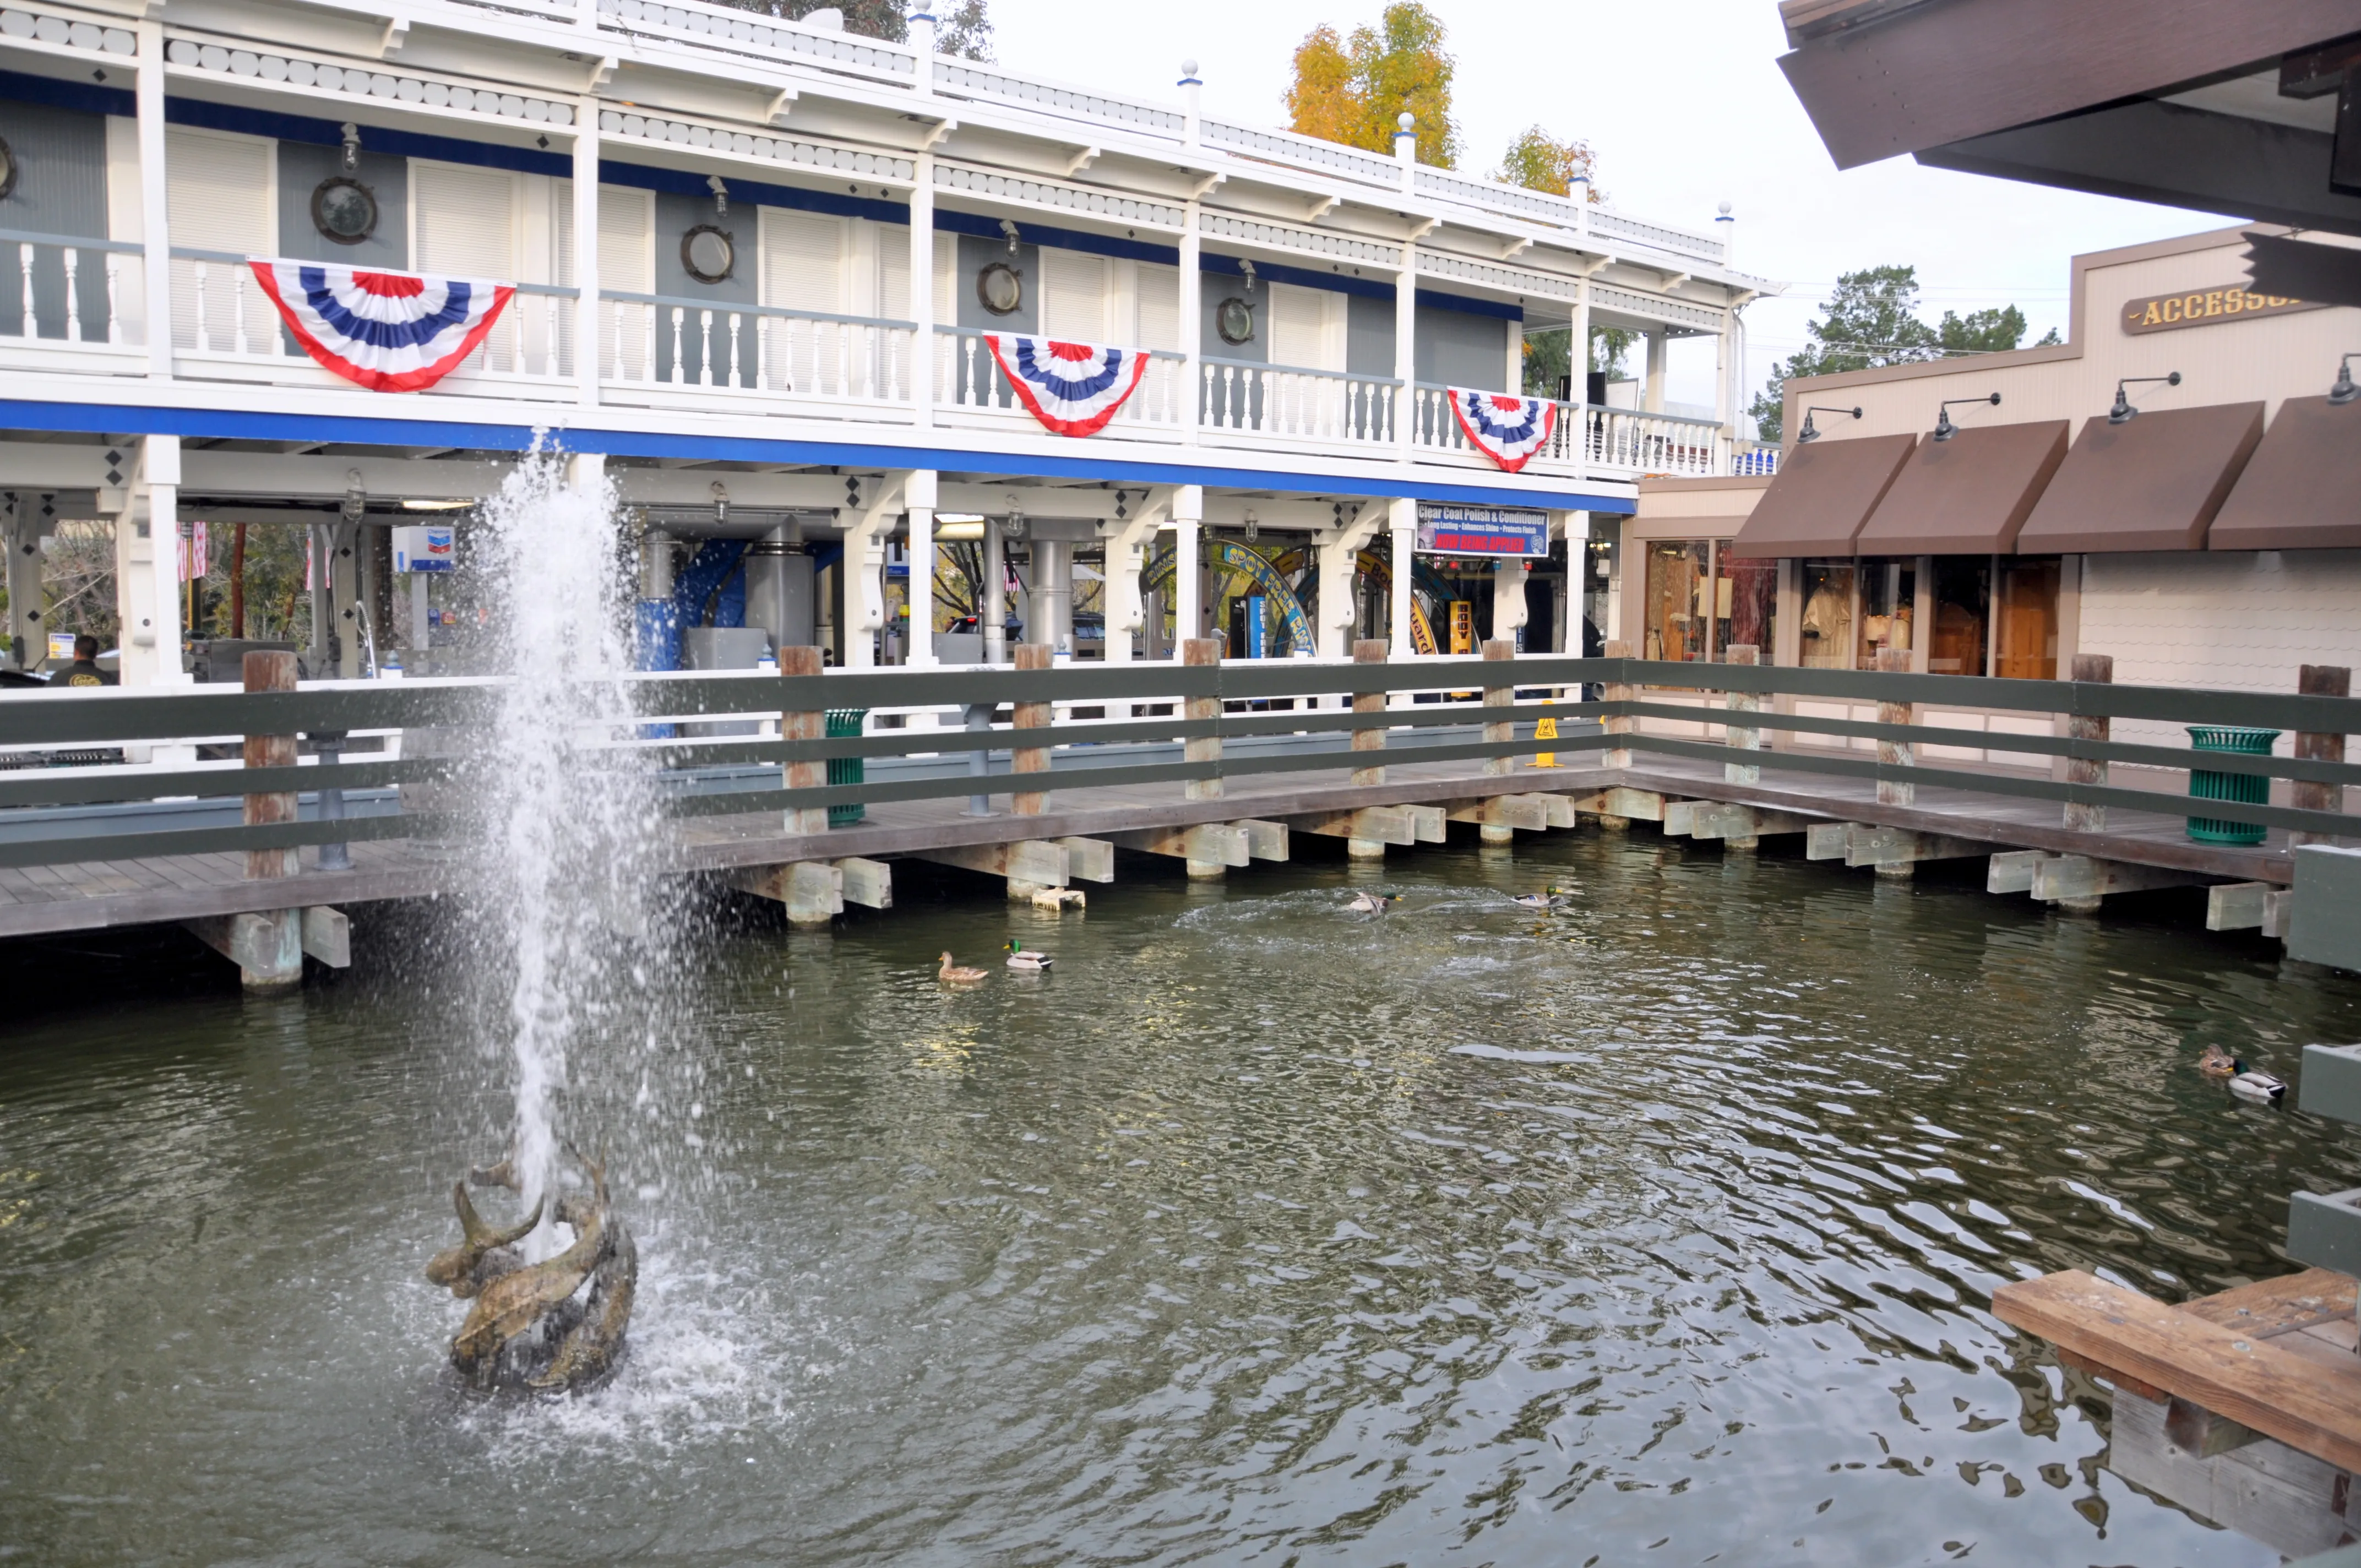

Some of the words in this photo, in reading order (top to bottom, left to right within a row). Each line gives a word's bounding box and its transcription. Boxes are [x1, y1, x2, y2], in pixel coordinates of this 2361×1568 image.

[2142, 288, 2301, 326] ACCESS
[1418, 505, 1441, 519] Clear
[1443, 507, 1464, 520] Coat
[1465, 508, 1490, 521] Polish
[1492, 513, 1498, 522] &
[1499, 511, 1545, 525] Conditioner
[1428, 521, 1439, 530] Long
[1440, 522, 1458, 531] Lasting
[1462, 523, 1485, 531] Enhances
[1503, 525, 1522, 533] Protects
[1435, 534, 1459, 549] NOW
[1460, 535, 1487, 550] BEING
[1489, 537, 1525, 552] APPLIED
[1147, 551, 1177, 585] RINS
[1228, 548, 1265, 578] SPOT
[1265, 573, 1294, 616] FREE
[1457, 604, 1468, 639] BODY
